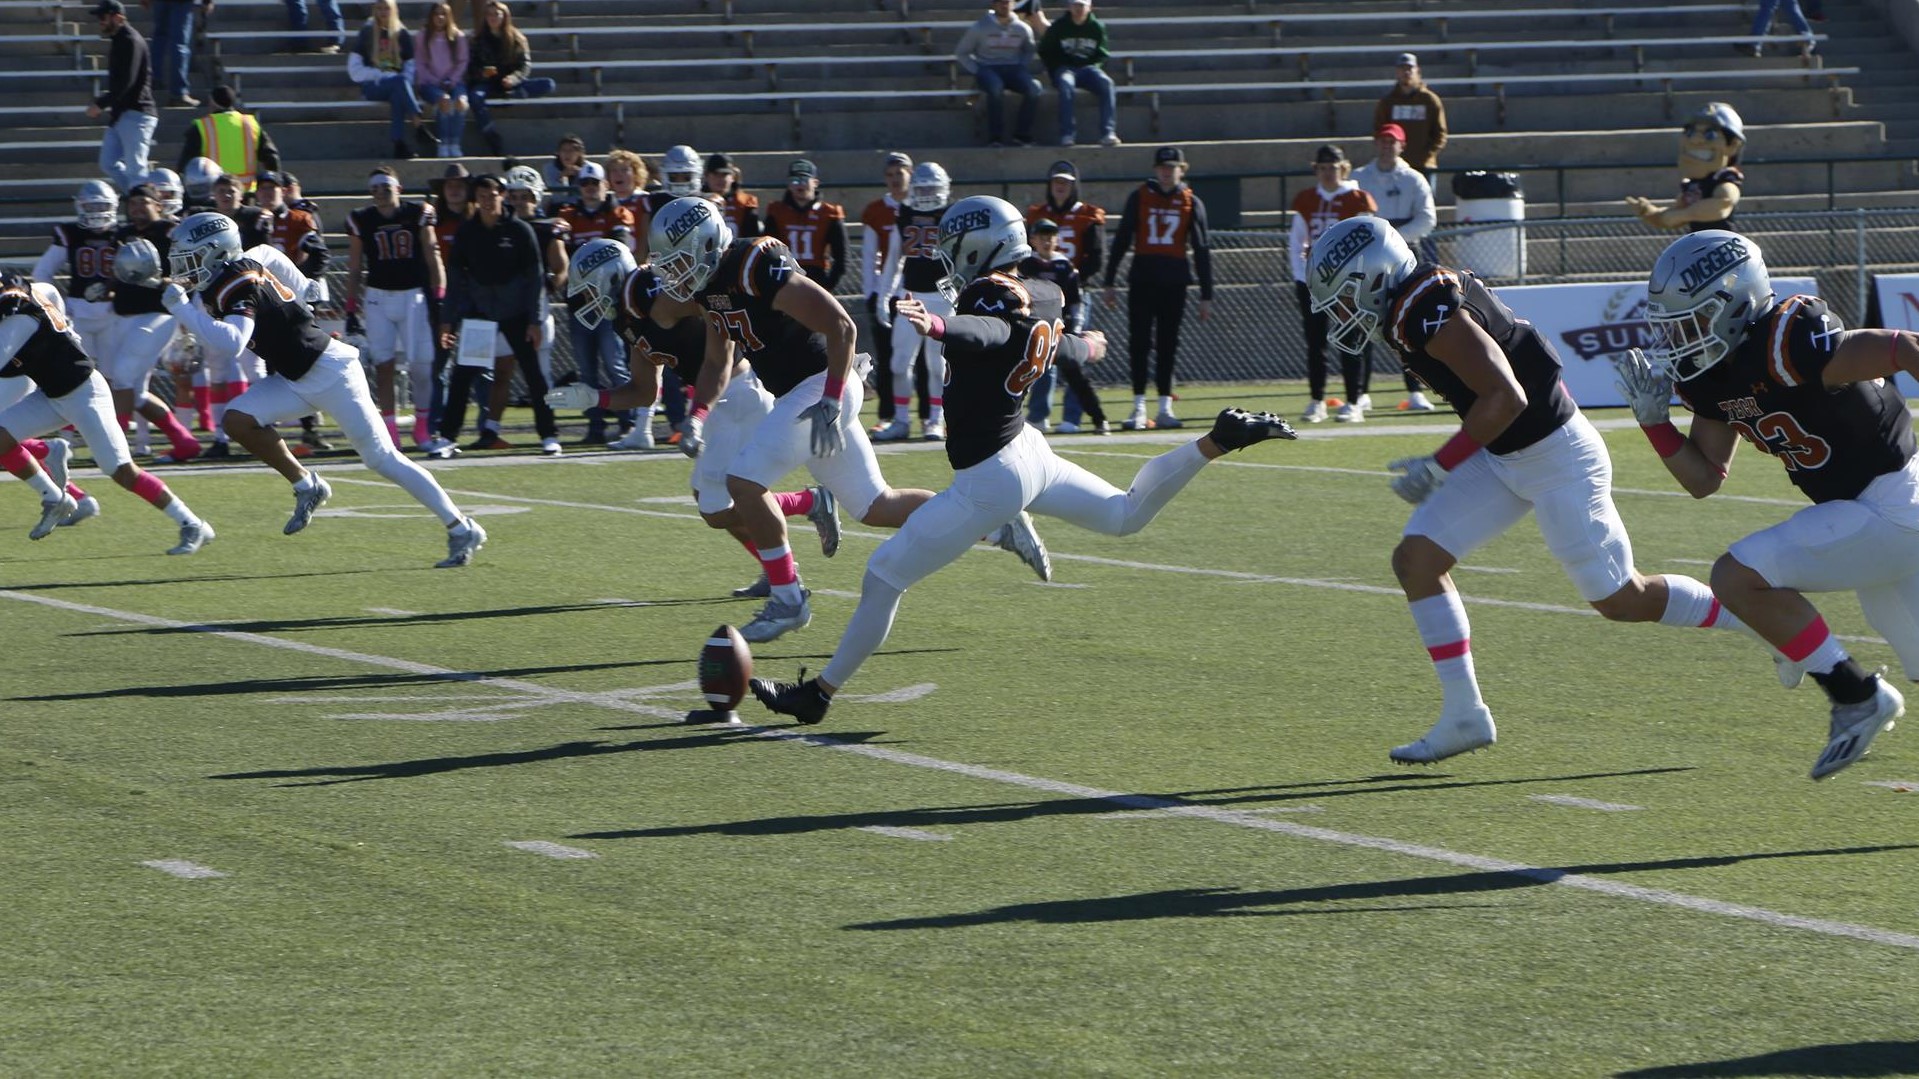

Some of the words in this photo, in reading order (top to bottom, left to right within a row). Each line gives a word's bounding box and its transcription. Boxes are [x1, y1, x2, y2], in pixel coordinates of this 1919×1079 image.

[665, 202, 710, 243] DIGGERS
[1147, 214, 1181, 245] 17
[787, 230, 815, 260] 11
[903, 225, 940, 259] 25
[1317, 224, 1373, 283] DIGGERS
[577, 243, 621, 276] DIGGERS
[1680, 238, 1748, 292] DIGGERS
[1718, 396, 1764, 420] TECH
